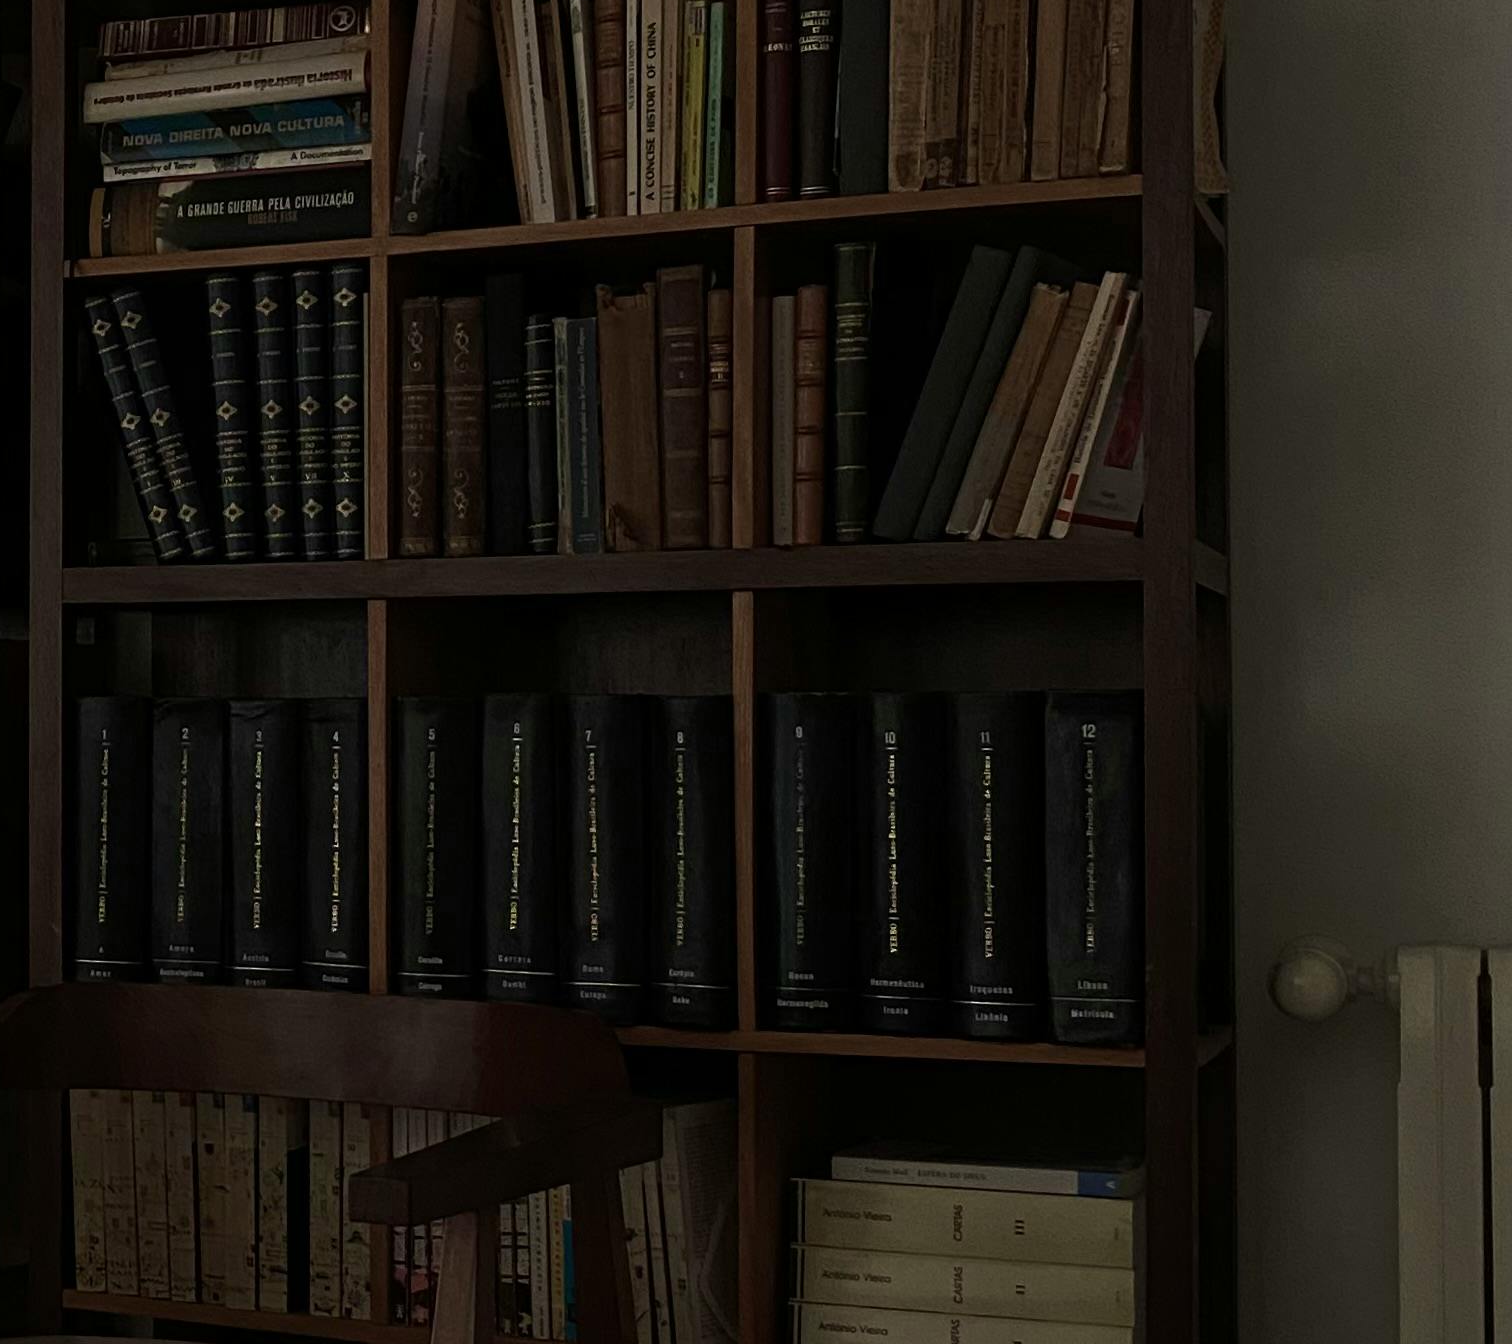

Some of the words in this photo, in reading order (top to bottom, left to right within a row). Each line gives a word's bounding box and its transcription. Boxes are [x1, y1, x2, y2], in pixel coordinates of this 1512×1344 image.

[646, 22, 657, 59] CHINA
[646, 64, 656, 79] OF
[646, 83, 656, 133] HISTORY
[122, 134, 162, 147] NOVA
[169, 125, 223, 144] DIREITA
[230, 121, 271, 137] NOVA
[277, 116, 345, 132] CULTURA
[290, 152, 297, 160] A
[299, 148, 364, 160] Documentation
[646, 137, 656, 187] CONCISE
[113, 164, 161, 177] Topography
[163, 164, 172, 172] of
[174, 161, 196, 170] Terror
[177, 205, 184, 217] A
[188, 202, 225, 216] GRANDE
[227, 199, 264, 214] GUERRA
[268, 197, 292, 211] PELA
[295, 189, 354, 210] CIVILIZAÇÃO
[646, 192, 655, 201] A
[101, 729, 107, 740] 1
[182, 727, 189, 740] 2
[255, 730, 262, 742] 3
[333, 730, 340, 742] 4
[428, 727, 436, 741] 5
[513, 722, 521, 734] 6
[584, 729, 593, 742] 7
[676, 731, 685, 745] 8
[795, 725, 803, 739] 9
[885, 731, 896, 745] 10
[981, 731, 990, 745] 11
[1082, 723, 1096, 738] 12
[98, 896, 106, 923] VERBO
[177, 895, 185, 923] VERBO
[253, 902, 261, 929] VERBO
[331, 905, 339, 932] VERBO
[425, 906, 434, 935] VERBO
[509, 902, 518, 930] VERBO
[590, 913, 599, 942] VERBO
[676, 916, 686, 946] VERBO
[795, 914, 805, 945] VERBO
[889, 923, 898, 953] VERBO
[1086, 922, 1095, 953] VERBO
[984, 927, 993, 958] VERBO
[952, 1204, 964, 1242] CARTAS
[1015, 1219, 1025, 1236] III
[953, 1266, 964, 1304] CARTAS
[1015, 1284, 1025, 1296] II
